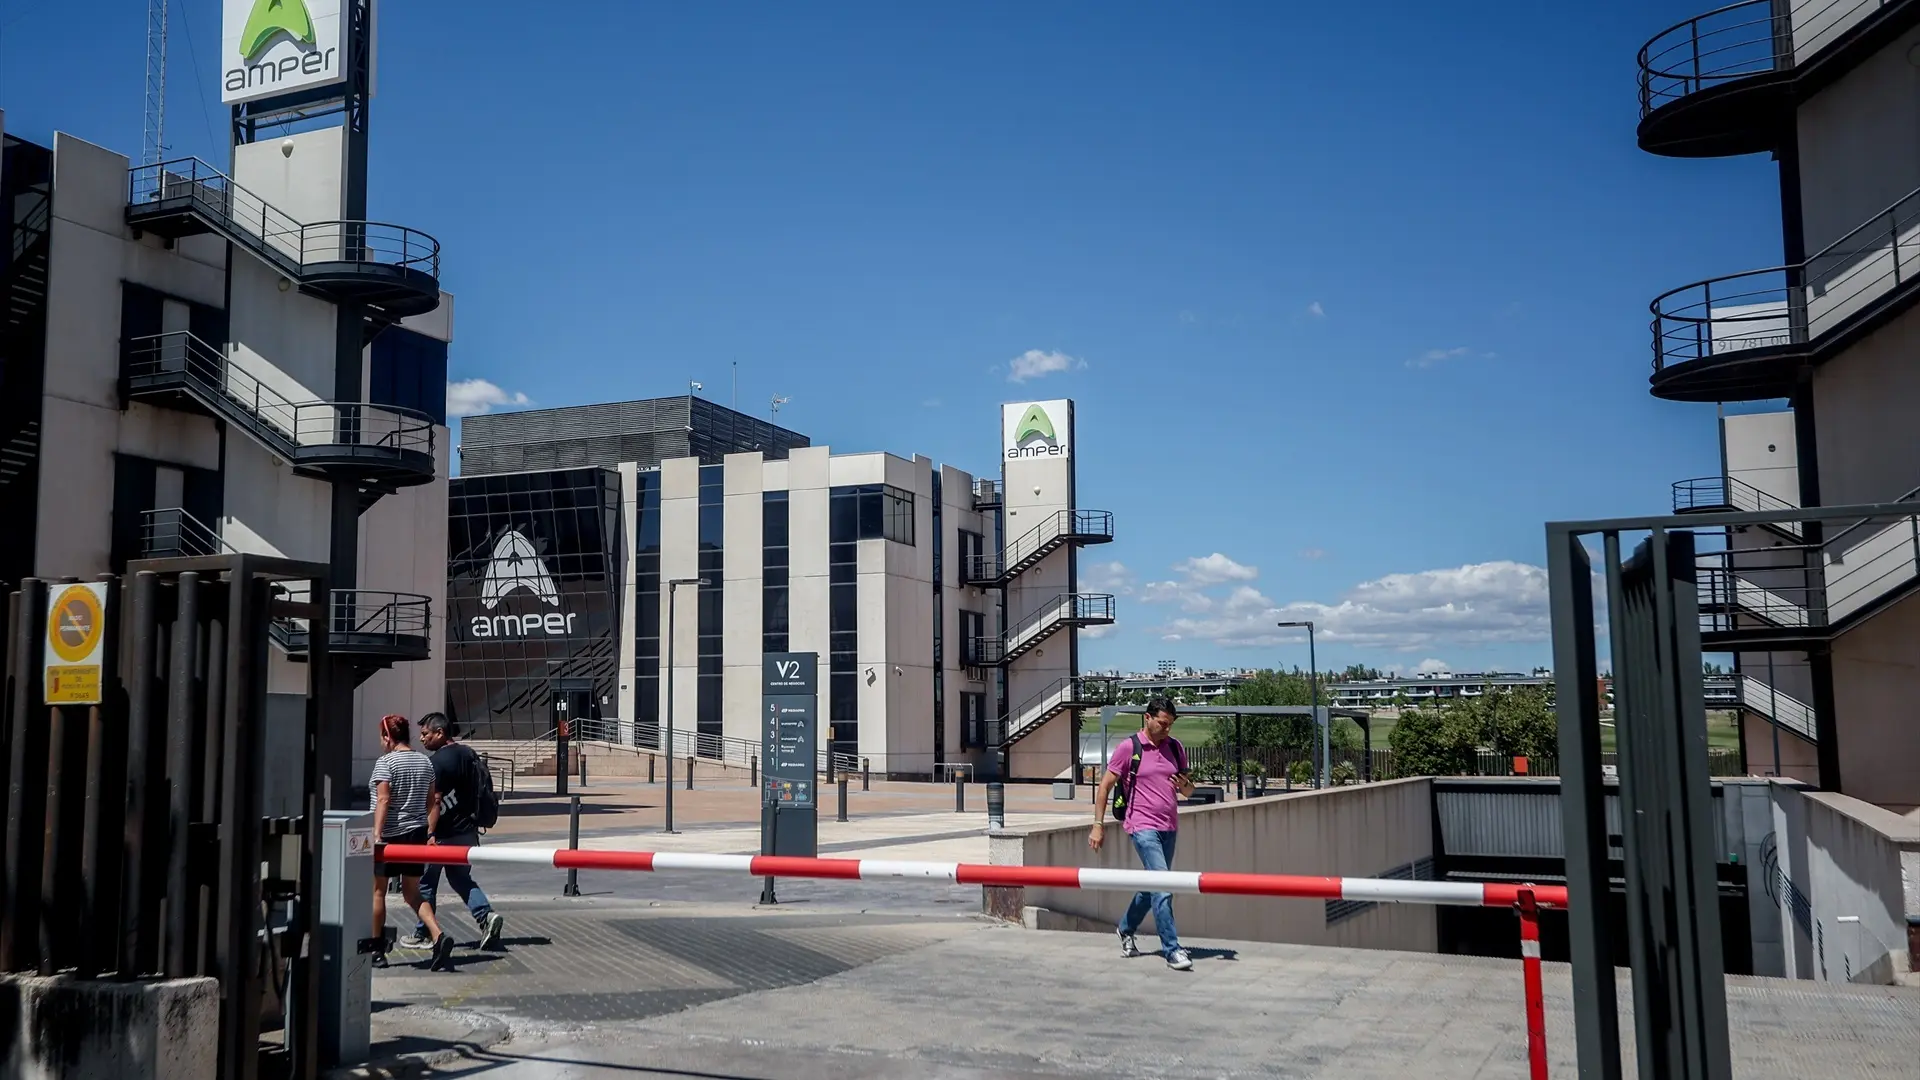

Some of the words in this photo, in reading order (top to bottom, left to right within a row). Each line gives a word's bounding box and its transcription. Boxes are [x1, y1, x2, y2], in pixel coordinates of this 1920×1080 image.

[225, 47, 336, 92] amper
[1718, 340, 1733, 352] 91
[1008, 445, 1066, 458] amper
[471, 612, 577, 637] amper
[775, 660, 800, 679] V2
[770, 703, 776, 712] 5
[770, 717, 775, 726] 4
[563, 722, 569, 733] 3
[770, 730, 775, 739] 3
[770, 744, 775, 753] 2
[771, 757, 775, 766] 1
